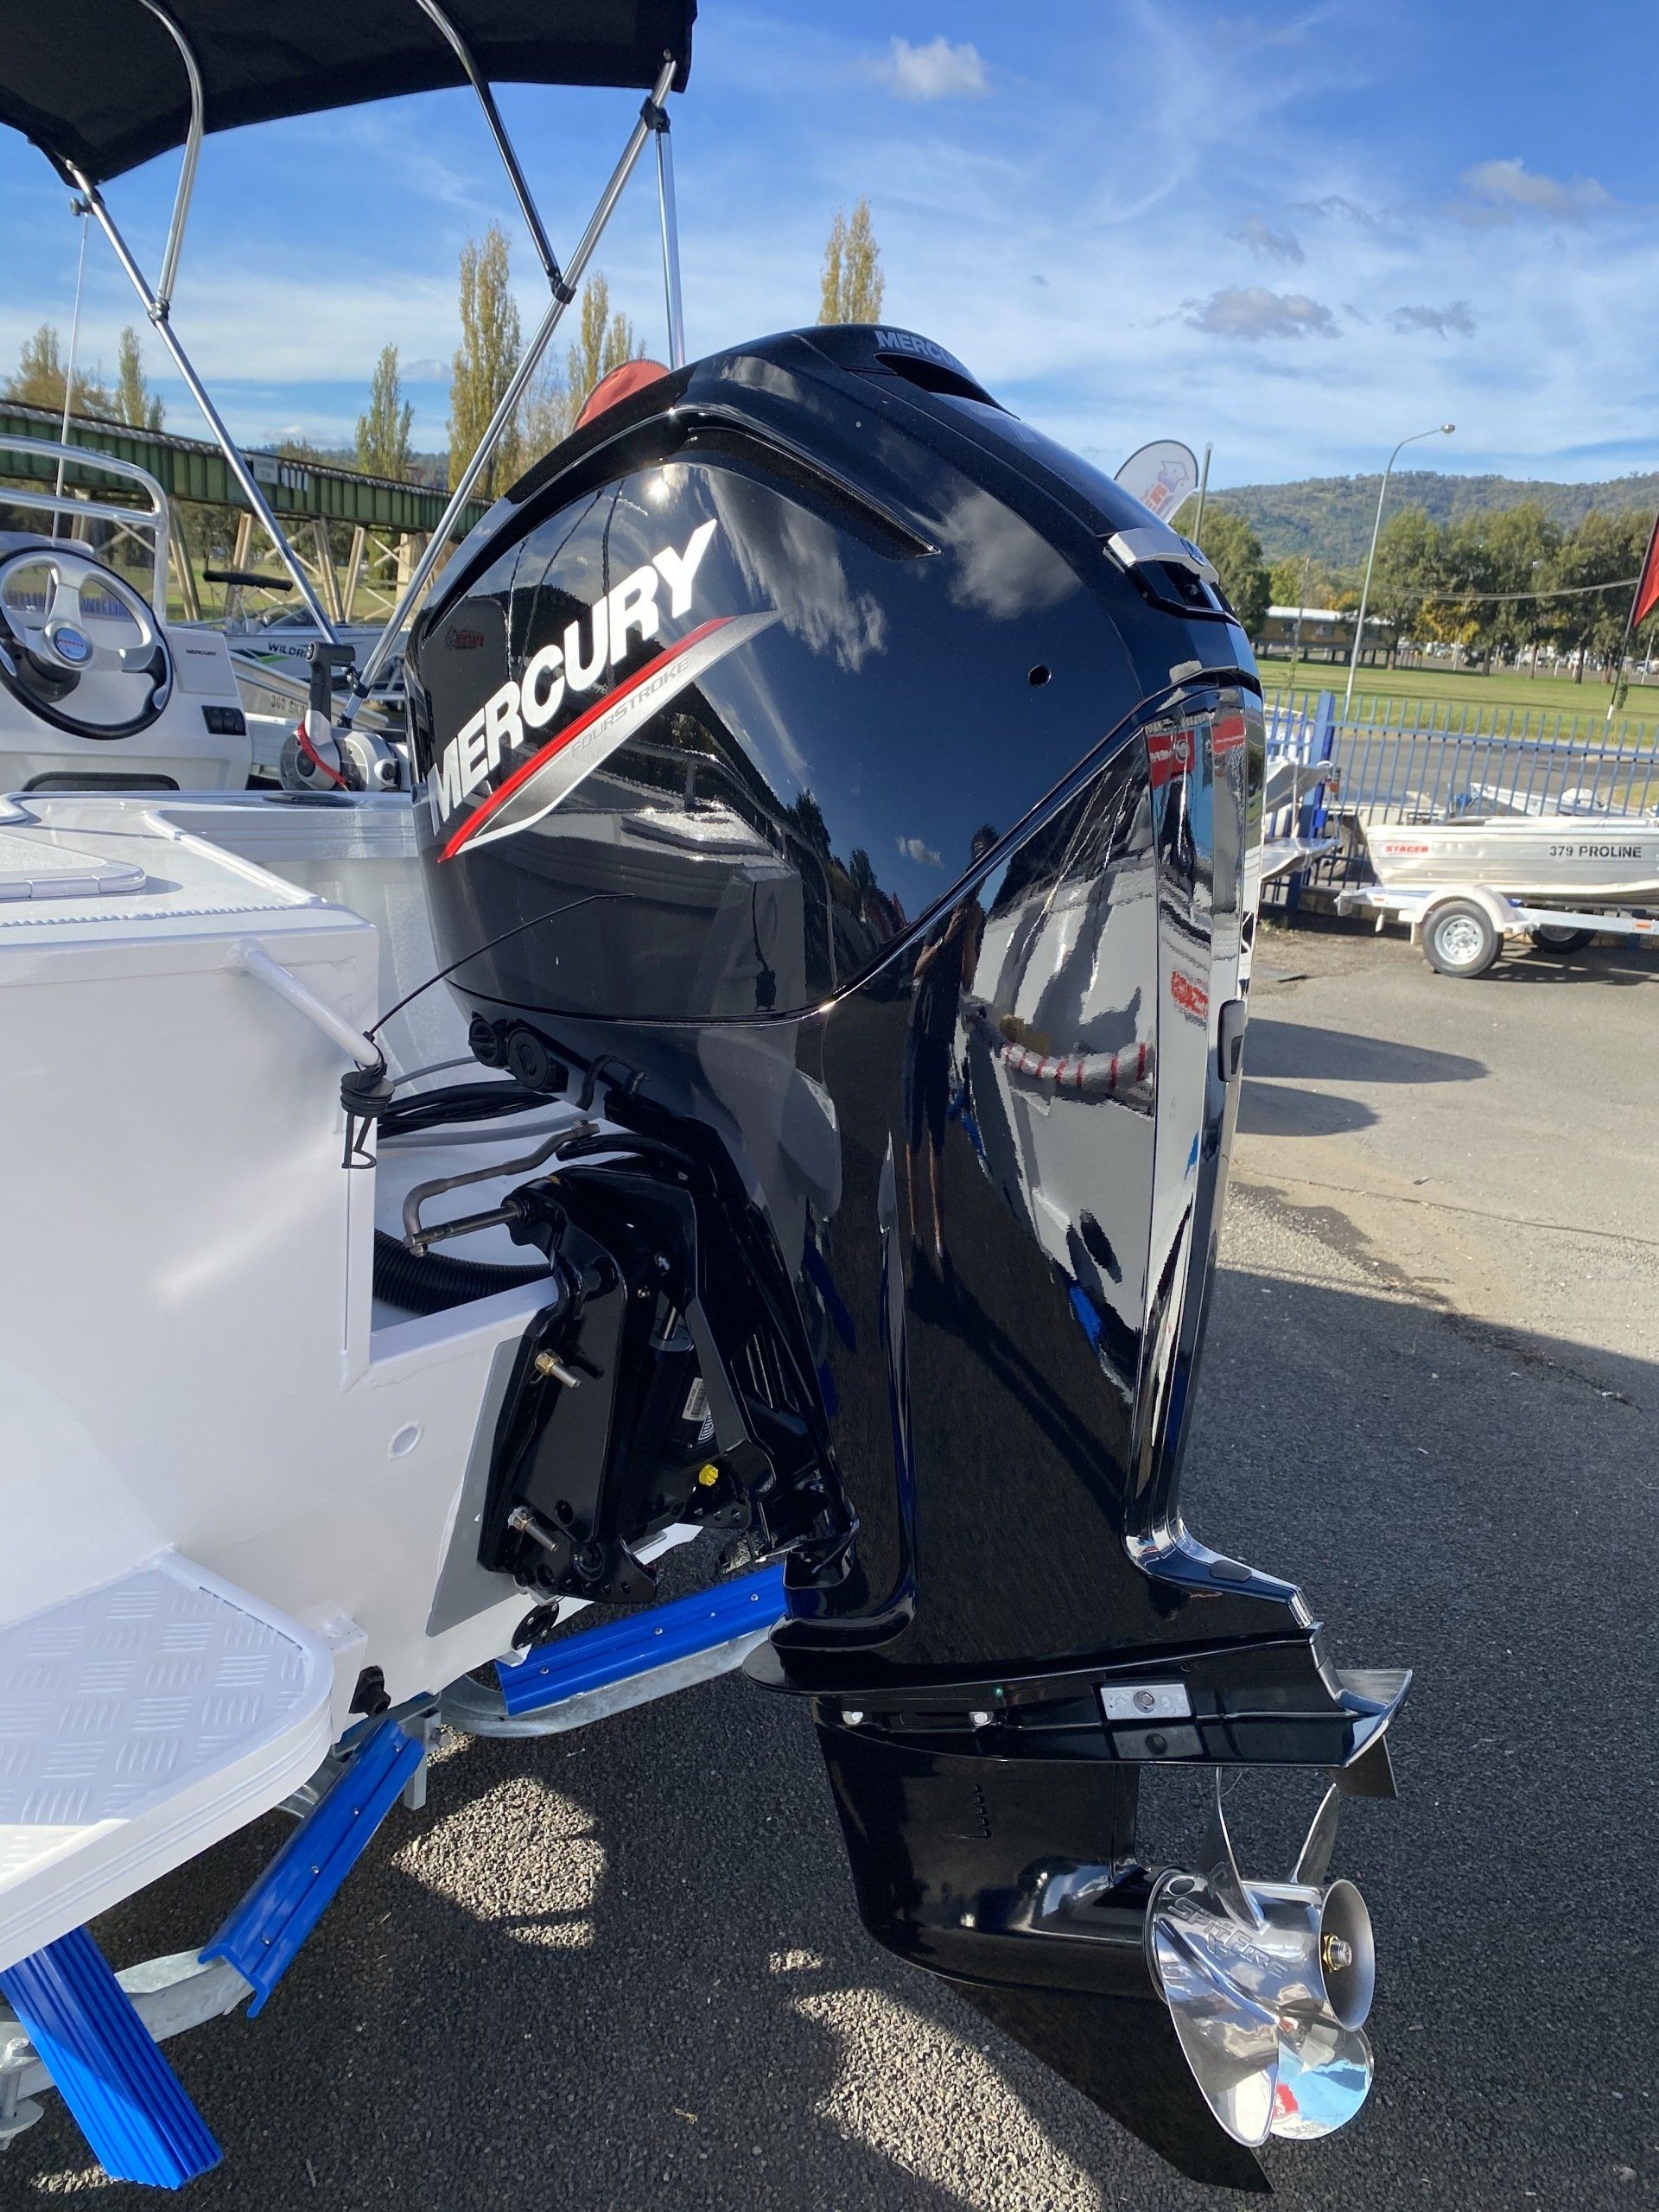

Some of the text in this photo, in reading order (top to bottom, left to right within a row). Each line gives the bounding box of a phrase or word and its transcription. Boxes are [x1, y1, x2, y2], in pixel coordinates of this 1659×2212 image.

[268, 642, 307, 658] WILDR
[428, 518, 717, 836] MERCURY
[569, 655, 689, 758] FOURSTROKE
[1549, 845, 1642, 858] 379 PROLINE
